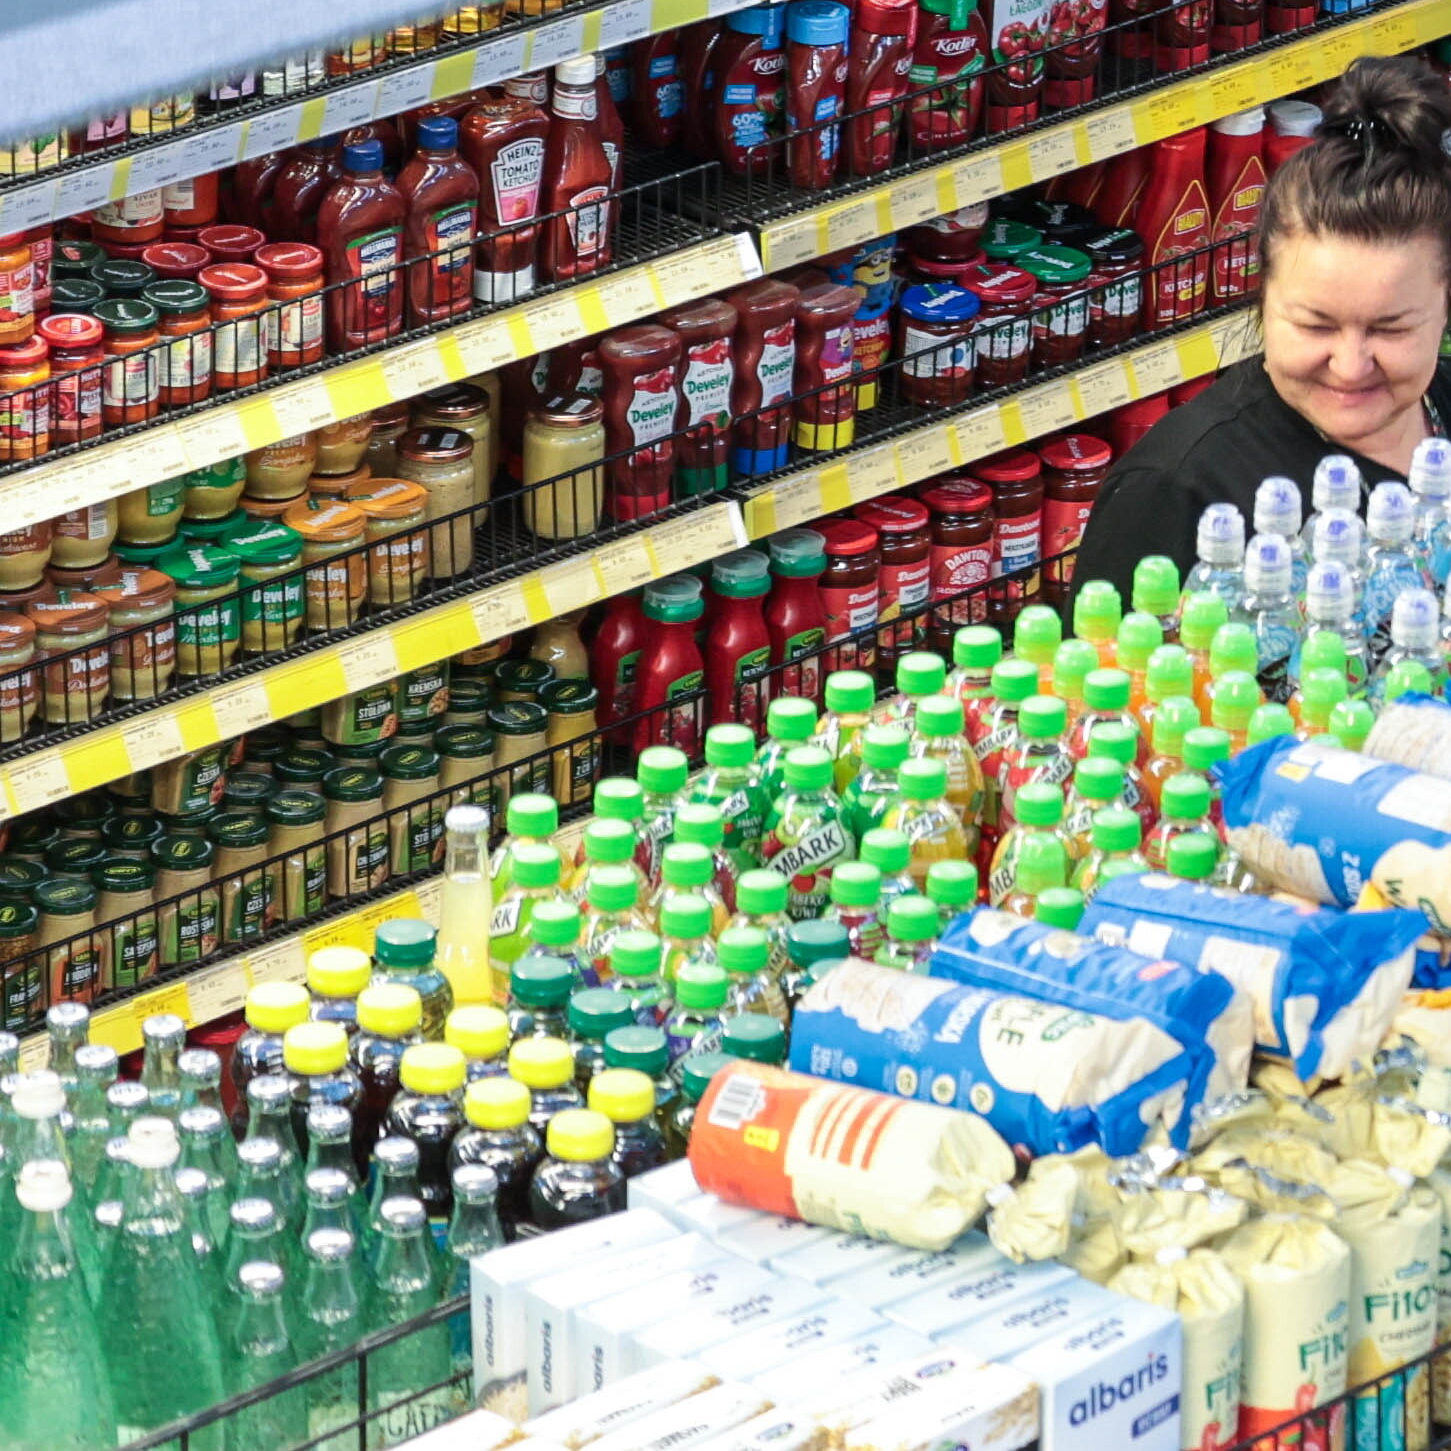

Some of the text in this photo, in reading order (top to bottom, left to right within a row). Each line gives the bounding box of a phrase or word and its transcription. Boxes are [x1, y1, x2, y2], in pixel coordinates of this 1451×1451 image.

[507, 145, 537, 162] HEINZ
[501, 160, 540, 178] TOMATO
[686, 374, 730, 399] Develey
[632, 402, 675, 426] Develey
[771, 824, 844, 883] MBARK
[1068, 1351, 1170, 1428] albaris
